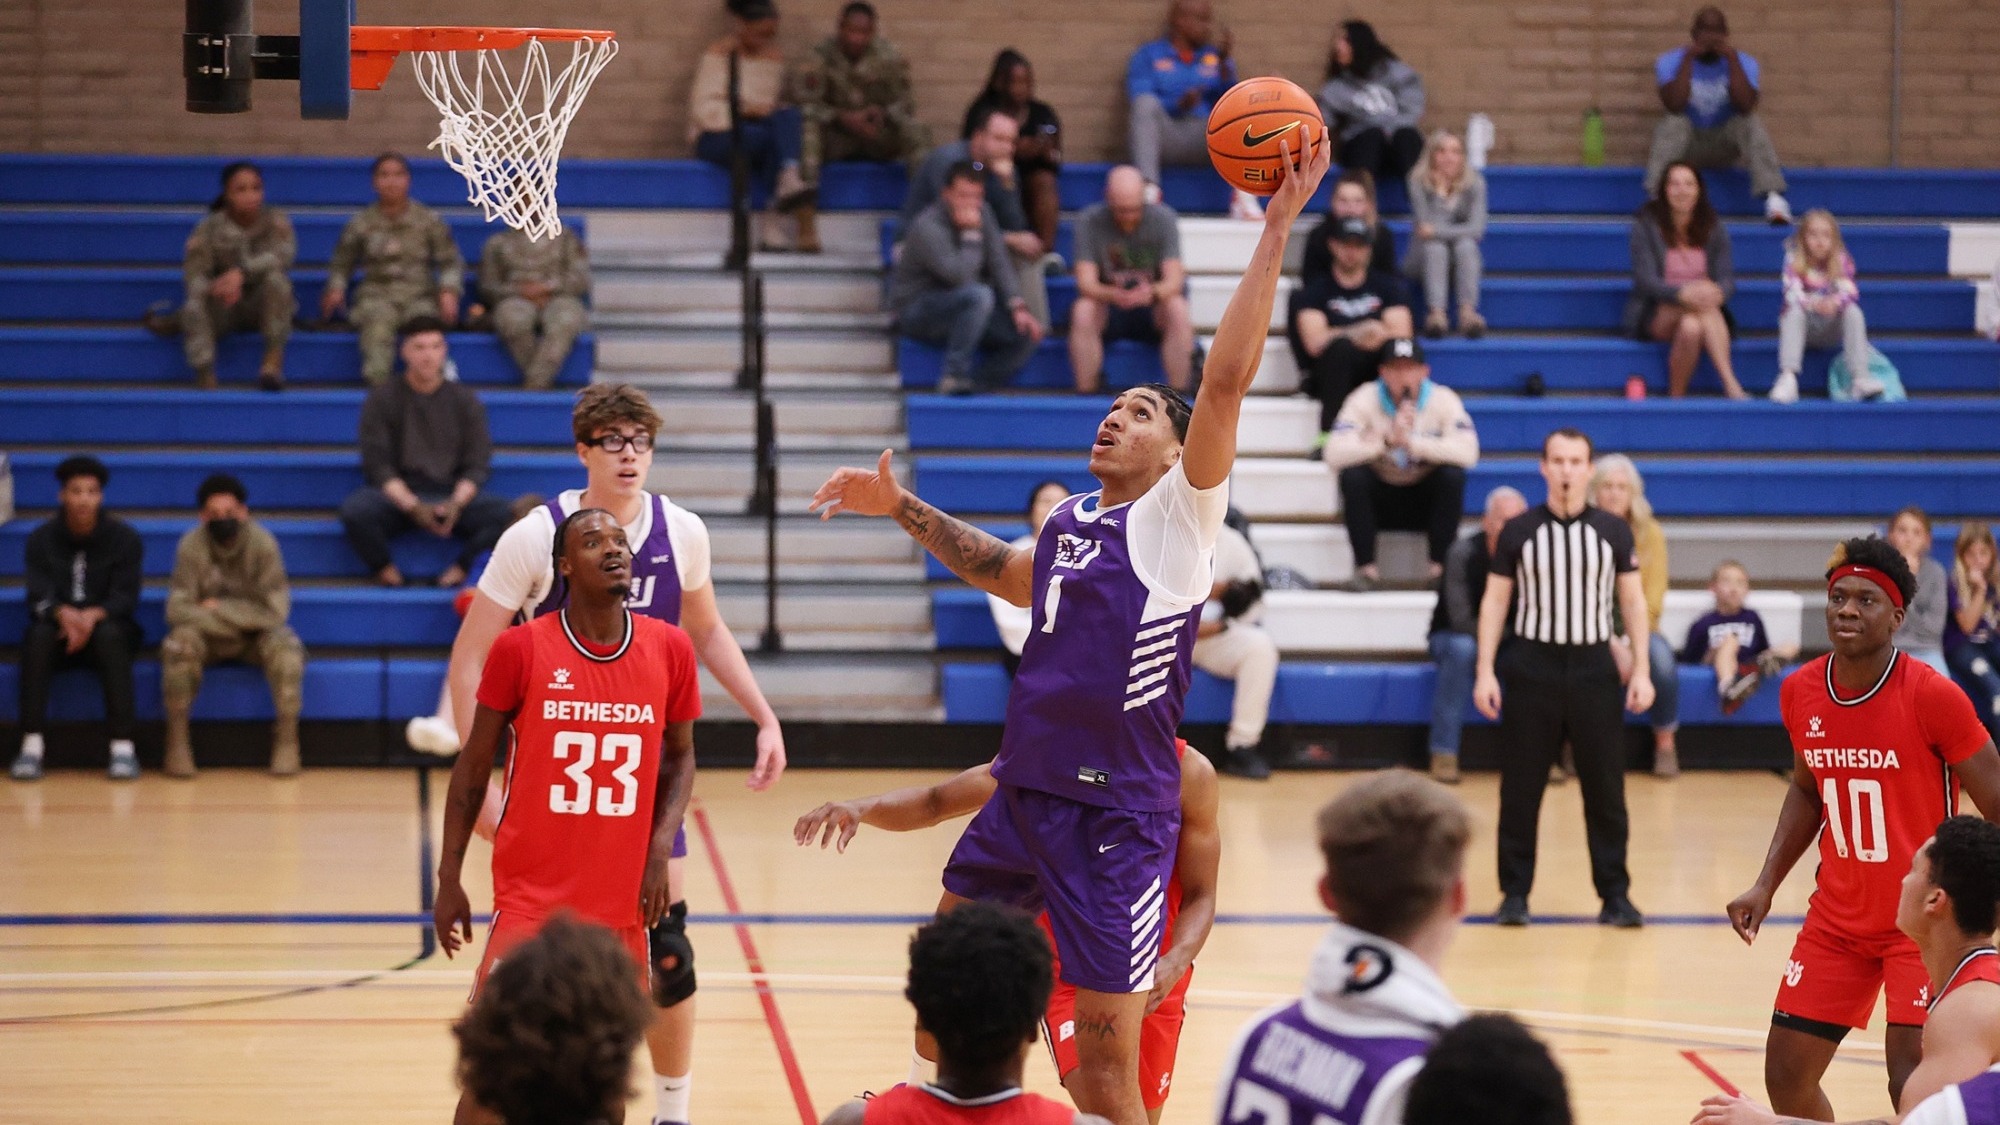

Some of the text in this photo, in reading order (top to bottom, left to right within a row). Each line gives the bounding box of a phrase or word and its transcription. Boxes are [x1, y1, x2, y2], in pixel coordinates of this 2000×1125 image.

[1101, 517, 1120, 527] WAC
[1041, 575, 1064, 633] 1
[543, 699, 656, 724] BETHESDA
[1803, 748, 1900, 769] BETHESDA
[549, 731, 643, 817] 33
[1823, 778, 1889, 863] 10
[1059, 1020, 1075, 1042] B
